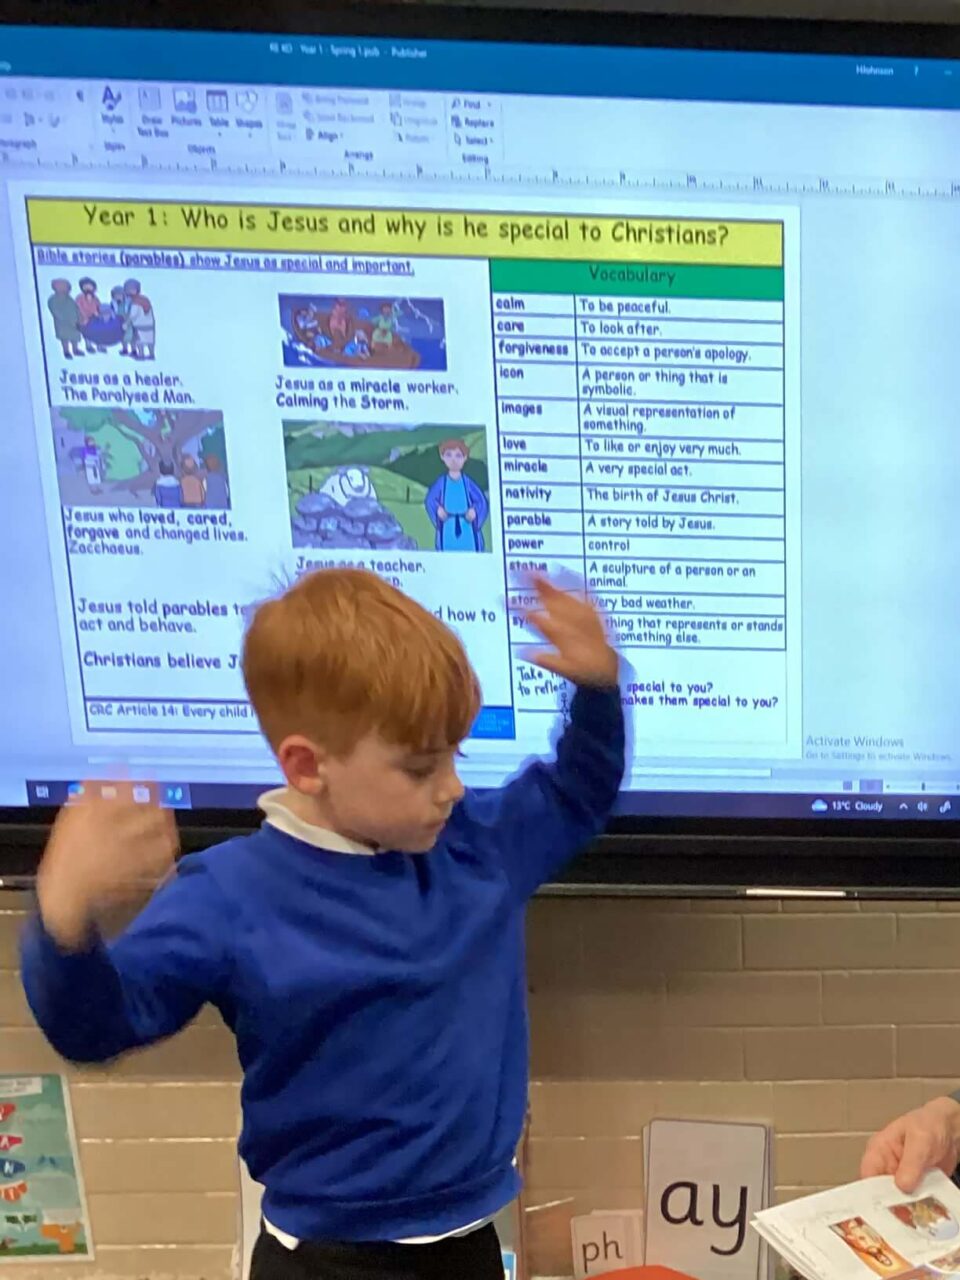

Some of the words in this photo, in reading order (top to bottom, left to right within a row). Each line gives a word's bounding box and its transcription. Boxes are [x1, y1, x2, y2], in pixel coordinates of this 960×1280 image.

[84, 204, 135, 227] Year
[149, 207, 167, 227] 1:
[181, 207, 228, 229] Who
[240, 209, 256, 230] is
[267, 210, 329, 233] Jesus
[339, 212, 375, 234] and
[386, 213, 426, 241] why
[437, 216, 453, 237] is
[464, 216, 488, 238] he
[499, 219, 569, 245] special
[580, 220, 601, 241] to
[612, 221, 728, 246] Christians?
[37, 249, 68, 265] Bible
[72, 251, 116, 266] stories
[120, 252, 185, 268] (parables)
[190, 253, 221, 269] show
[225, 254, 260, 270] Jesus
[281, 256, 322, 273] special
[589, 265, 676, 287] Vocabulary
[496, 296, 525, 310] calm
[580, 299, 595, 312] To
[599, 300, 613, 313] be
[618, 300, 670, 318] peaceful.
[497, 321, 524, 332] care
[581, 321, 595, 334] To
[600, 321, 624, 335] look
[627, 322, 662, 336] after.
[499, 340, 568, 357] forgiveness
[581, 343, 596, 355] To
[600, 344, 639, 360] accept
[654, 346, 701, 360] person's
[705, 347, 751, 363] apology.
[60, 369, 100, 385] Jesus
[135, 370, 183, 387] healer.
[500, 365, 524, 379] icon
[595, 370, 634, 383] person
[655, 369, 685, 386] thing
[689, 371, 714, 384] that
[275, 375, 314, 390] Jesus
[351, 378, 401, 394] miracle
[407, 380, 459, 395] worker.
[582, 382, 636, 397] symbolic.
[61, 386, 88, 401] The
[92, 387, 160, 406] Paralysed
[163, 389, 195, 404] Man.
[276, 393, 328, 411] Calming
[334, 395, 357, 408] the
[361, 394, 409, 411] Storm.
[502, 401, 542, 418] images
[596, 404, 629, 417] visual
[633, 406, 719, 421] representation
[723, 406, 736, 420] of
[584, 419, 647, 434] something.
[503, 436, 527, 450] love
[585, 439, 599, 452] To
[604, 439, 624, 452] like
[645, 441, 676, 457] enjoy
[680, 443, 705, 458] very
[708, 441, 741, 456] much.
[504, 459, 548, 473] miracle
[599, 463, 624, 478] very
[628, 462, 667, 478] special
[505, 486, 552, 502] nativity
[586, 488, 609, 501] The
[613, 488, 642, 502] birth
[647, 489, 659, 502] of
[663, 489, 697, 503] Jesus
[700, 491, 739, 505] Christ.
[65, 507, 104, 521] Jesus
[109, 507, 135, 522] who
[140, 509, 180, 526] loved,
[187, 511, 232, 527] cared,
[507, 513, 552, 528] parable
[601, 516, 632, 531] story
[636, 516, 658, 529] told
[662, 517, 676, 532] by
[679, 517, 715, 530] Jesus.
[67, 524, 119, 541] forgave
[125, 525, 150, 540] and
[154, 526, 209, 544] changed
[213, 527, 248, 542] lives.
[69, 540, 144, 556] Zacchaeus.
[508, 538, 544, 551] power
[588, 540, 630, 552] control
[510, 560, 548, 572] statue
[602, 562, 655, 577] sculpture
[660, 563, 671, 575] of
[686, 565, 723, 579] person
[742, 567, 756, 577] an
[78, 598, 122, 613] Jesus
[128, 598, 158, 614] told
[162, 601, 228, 618] parables
[621, 596, 642, 608] bad
[646, 597, 695, 610] weather.
[447, 606, 476, 622] how
[482, 608, 496, 622] to
[80, 618, 103, 631] act
[108, 617, 135, 632] and
[139, 617, 197, 633] behave.
[637, 617, 662, 630] that
[666, 618, 727, 633] represents
[747, 619, 783, 632] stands
[615, 631, 672, 648] something
[84, 650, 161, 667] Christians
[167, 652, 221, 669] believe
[517, 666, 544, 681] Take
[535, 680, 567, 696] reflect
[627, 681, 665, 695] special
[670, 681, 682, 693] to
[687, 682, 713, 696] you?
[659, 694, 688, 706] them
[693, 695, 730, 709] special
[735, 696, 748, 707] to
[753, 696, 779, 710] you?
[117, 703, 158, 717] Article
[182, 704, 215, 719] Every
[220, 704, 248, 718] child
[855, 801, 883, 813] Cloudy
[660, 1180, 748, 1257] ay
[582, 1231, 623, 1272] ph
